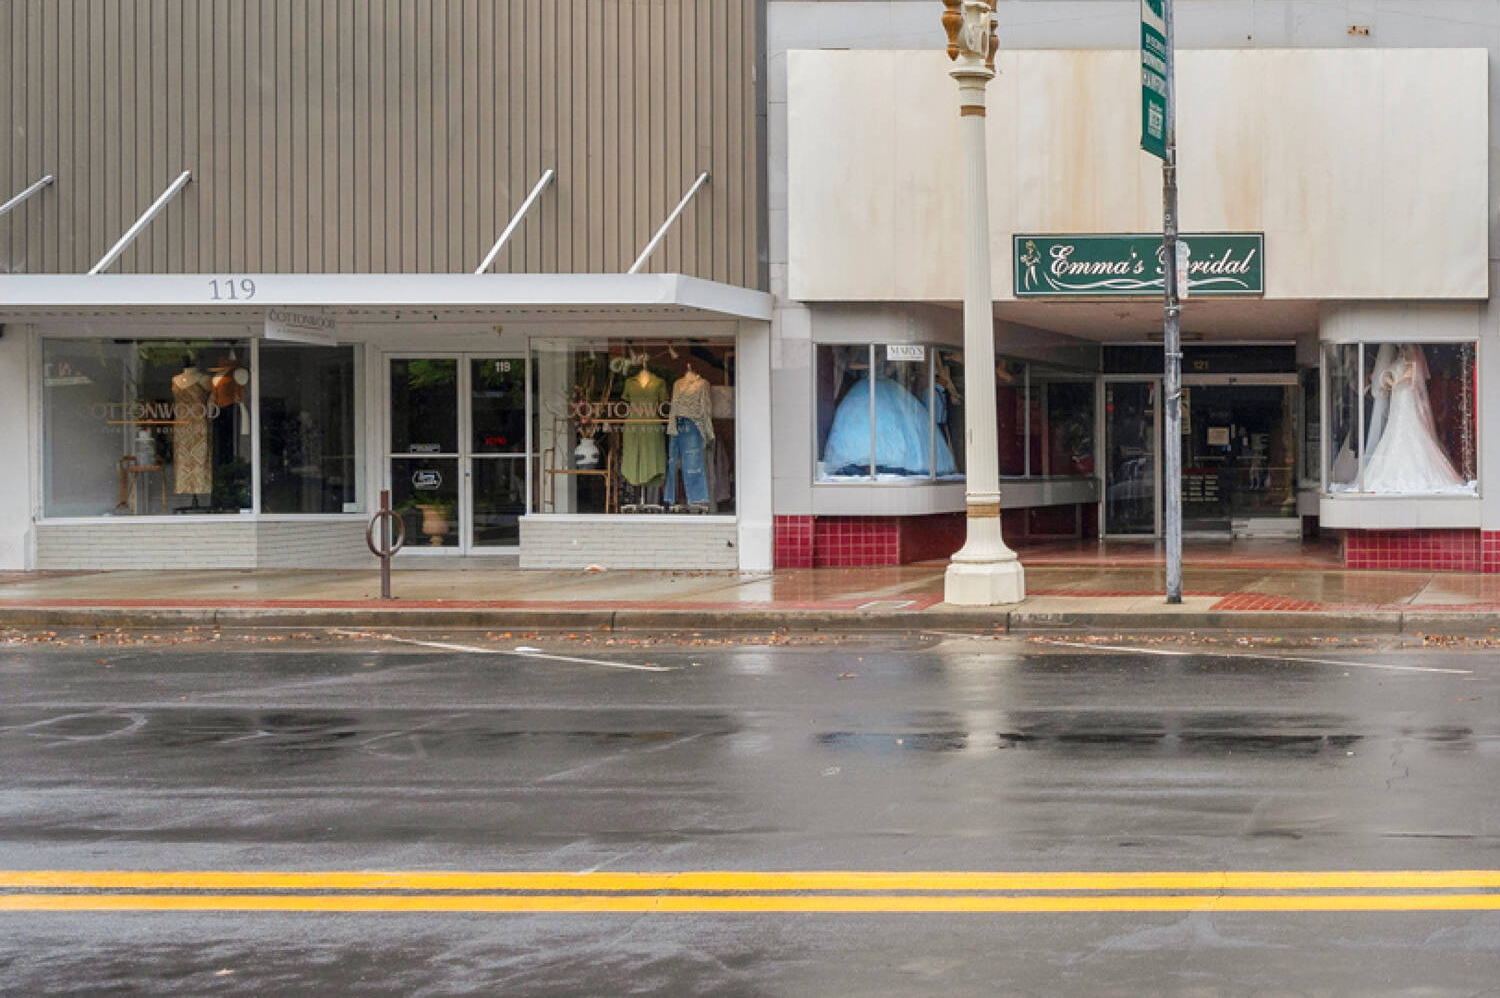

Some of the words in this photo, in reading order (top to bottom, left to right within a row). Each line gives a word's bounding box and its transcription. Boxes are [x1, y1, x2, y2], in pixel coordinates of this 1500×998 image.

[1050, 245, 1144, 277] Emma's
[208, 278, 256, 300] 119
[495, 361, 511, 373] 119
